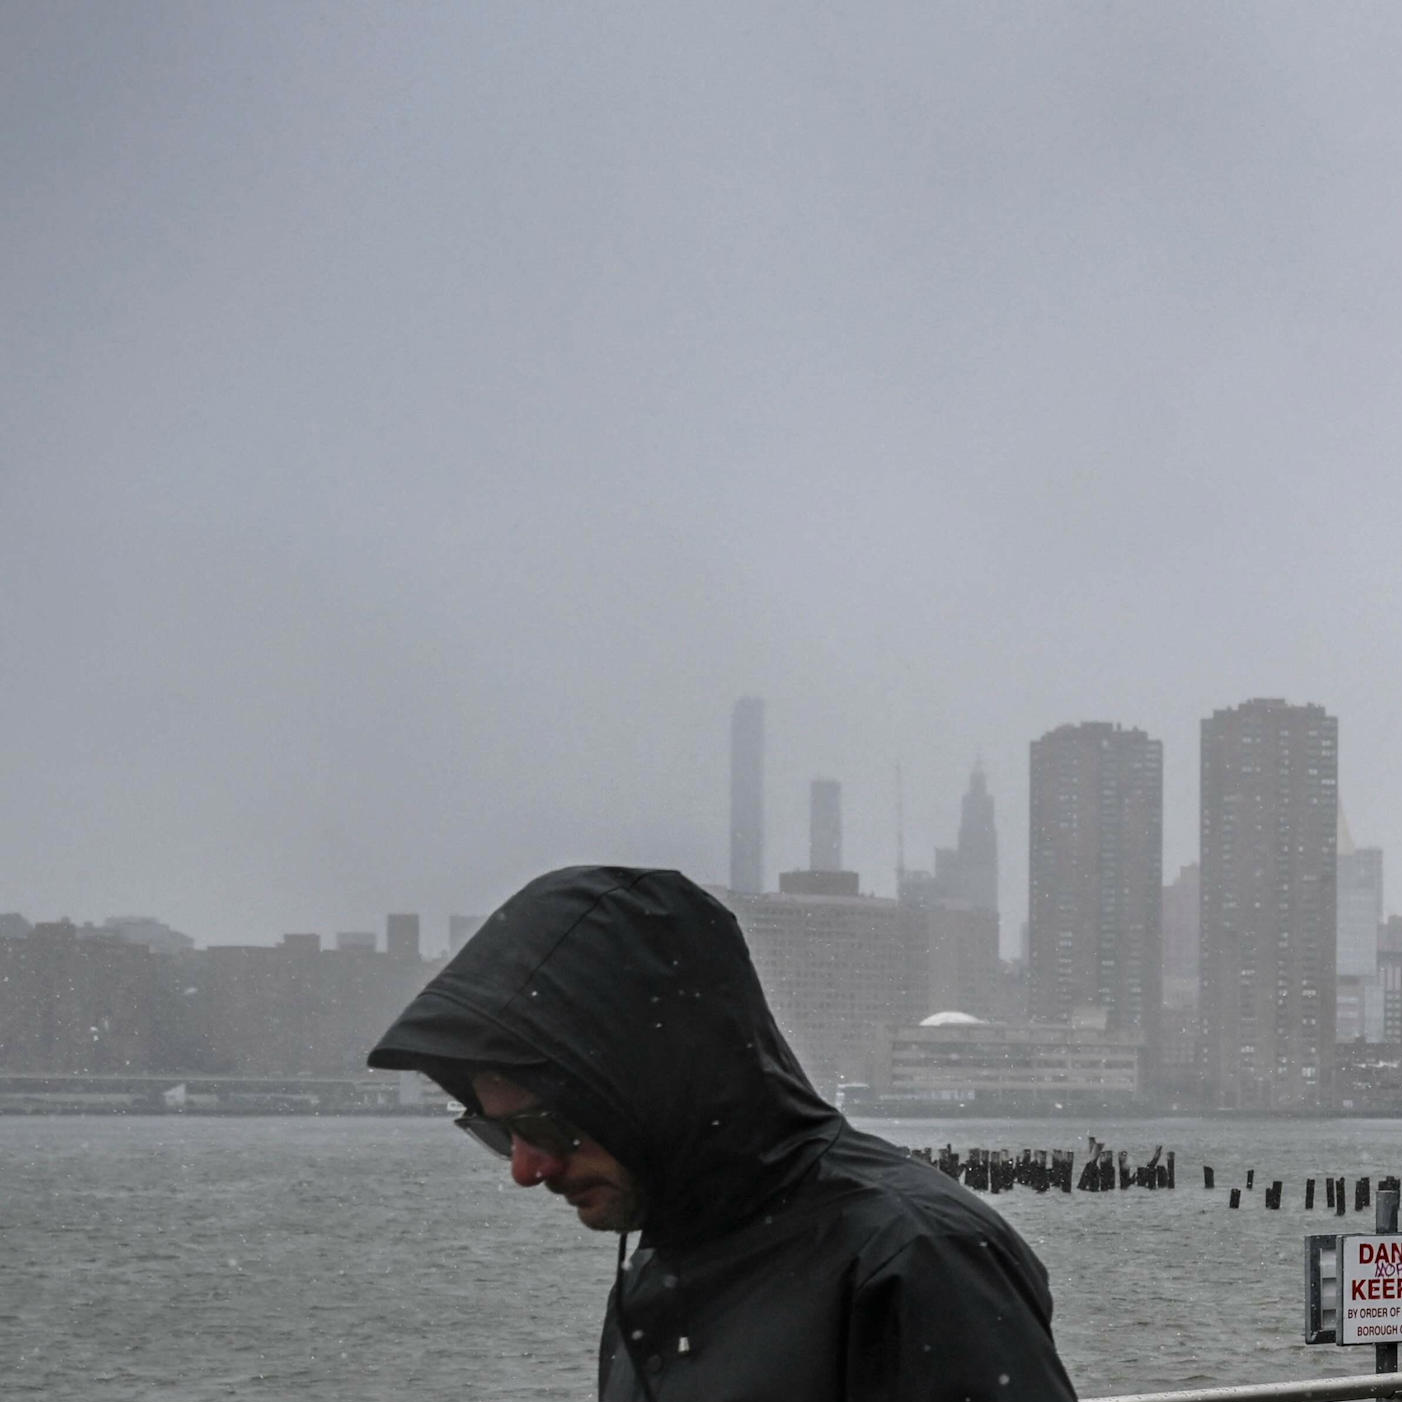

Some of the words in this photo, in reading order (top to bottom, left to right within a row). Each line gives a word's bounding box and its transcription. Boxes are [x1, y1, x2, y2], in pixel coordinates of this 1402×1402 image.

[1347, 1309, 1358, 1319] BY
[1359, 1307, 1388, 1318] ORDER
[1389, 1306, 1401, 1317] OF
[1357, 1324, 1398, 1337] BOROUGH
